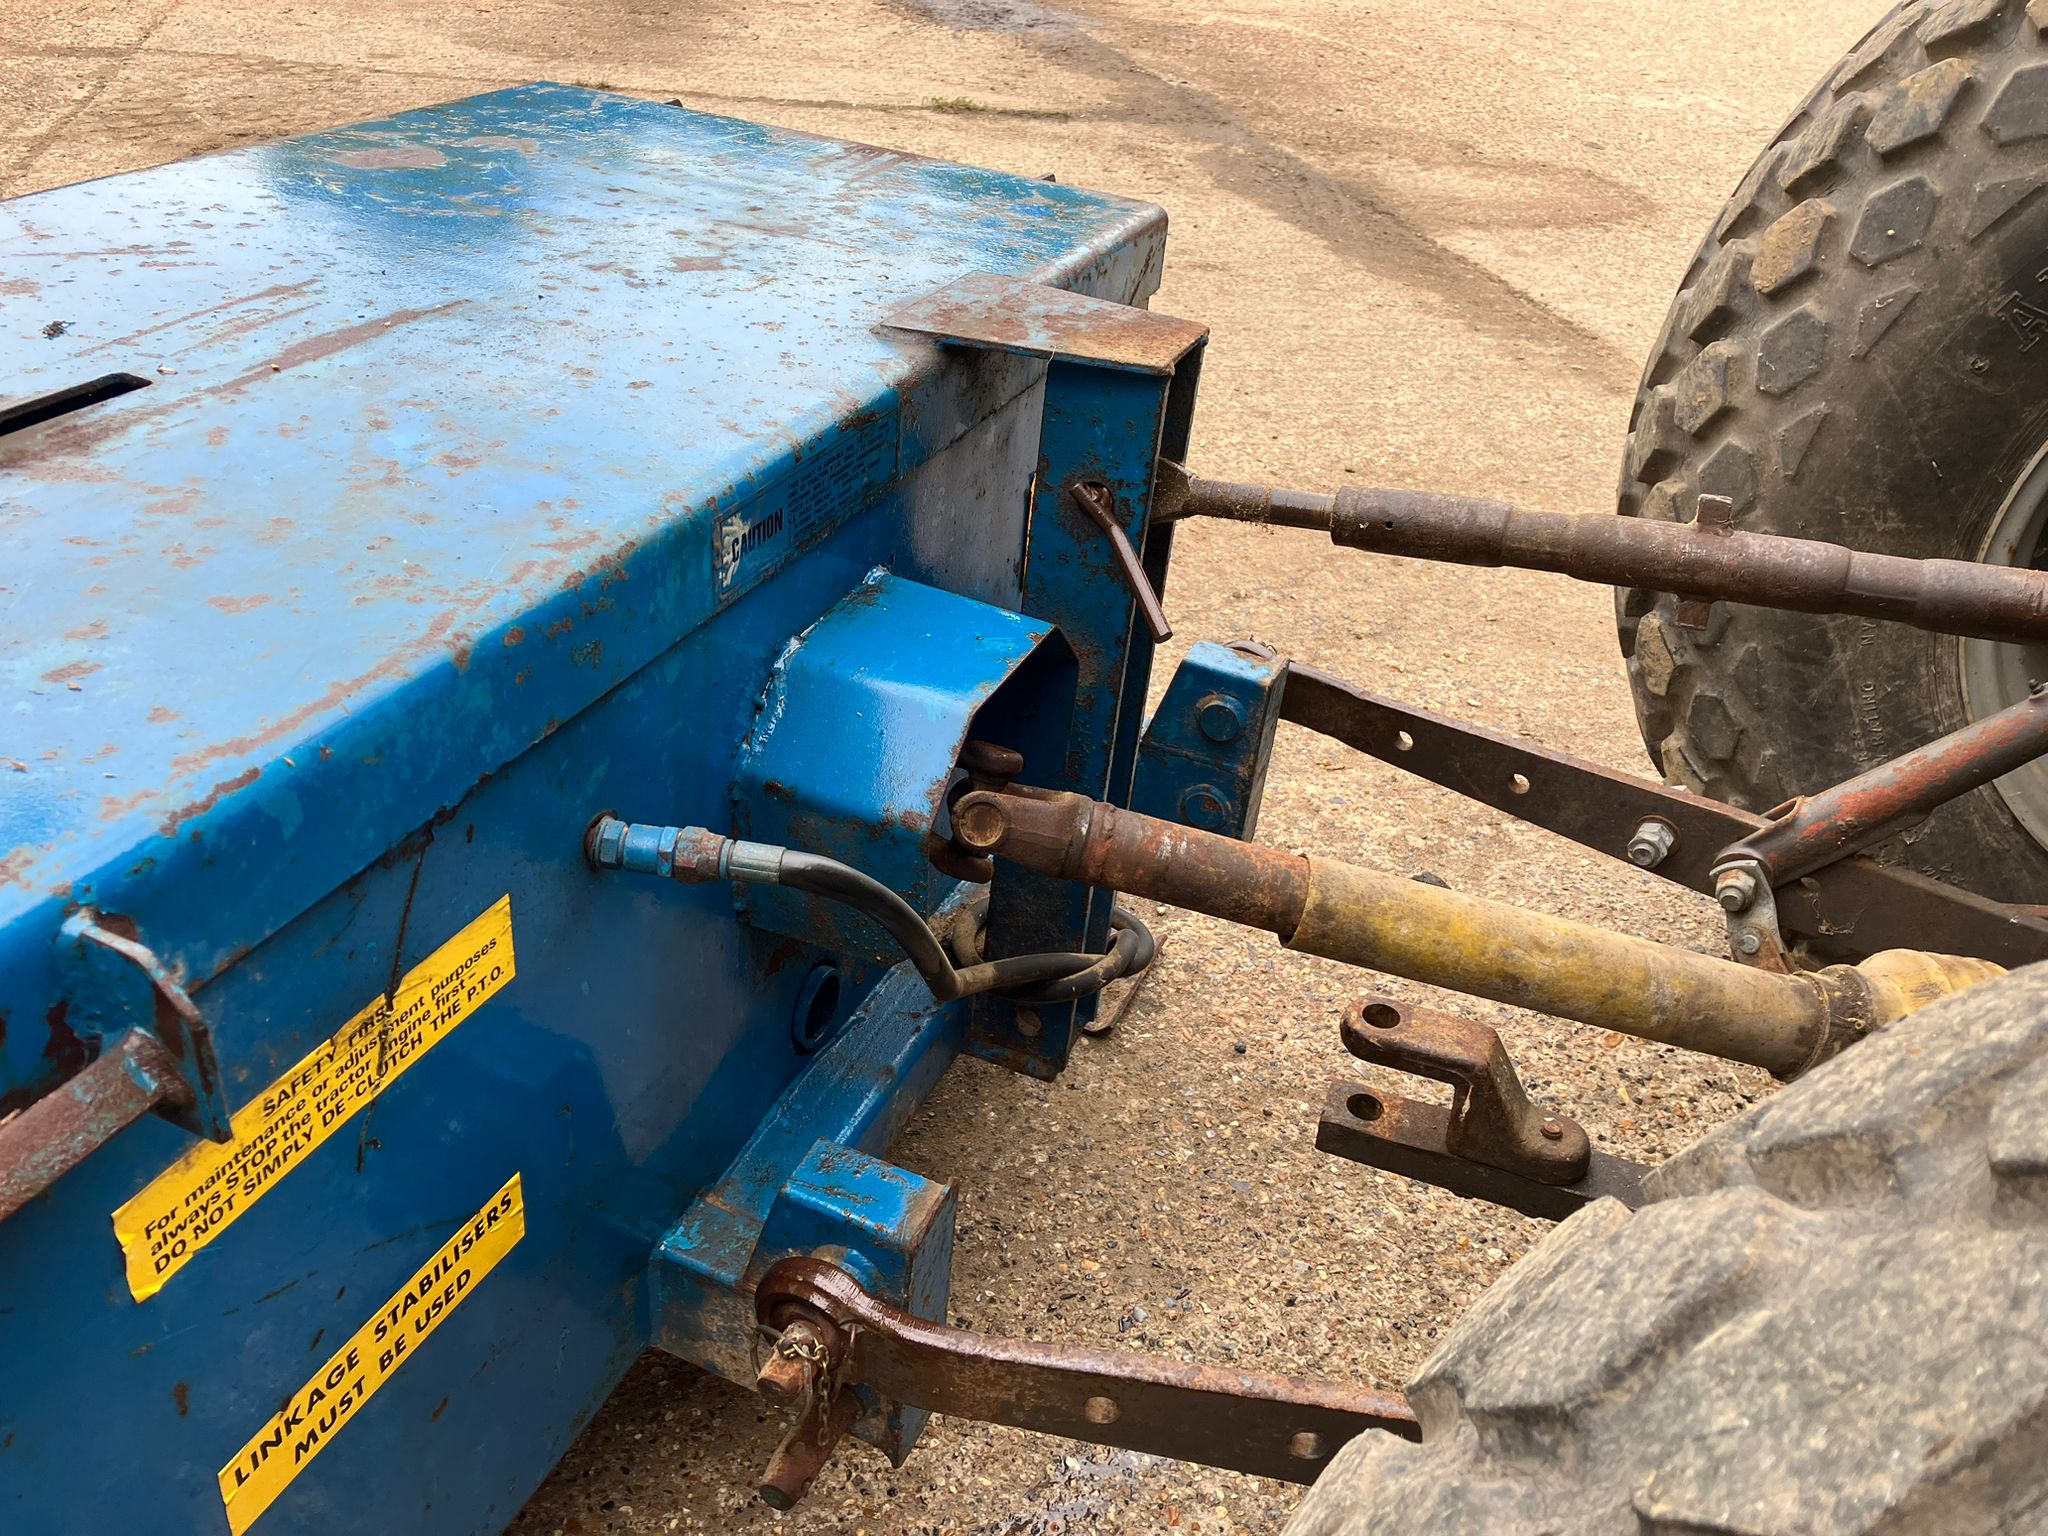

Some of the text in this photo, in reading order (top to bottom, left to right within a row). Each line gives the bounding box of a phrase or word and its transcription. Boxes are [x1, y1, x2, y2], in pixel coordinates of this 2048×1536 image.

[731, 507, 784, 563] CAUTION
[145, 1205, 178, 1240] For
[184, 1098, 306, 1208] maintenance
[312, 1079, 329, 1103] or
[431, 937, 497, 1000] purposes
[150, 1190, 221, 1257] always
[226, 1138, 277, 1192] STOP
[281, 1111, 311, 1142] the
[315, 1060, 372, 1113] tractor
[435, 979, 464, 1011] first
[155, 1244, 187, 1275] DO
[194, 1200, 235, 1242] NOT
[244, 1128, 315, 1197] SIMPLY
[430, 1000, 462, 1037] THE
[467, 965, 504, 1005] P.T.O.
[263, 1005, 392, 1117] SAFETY FIRS
[234, 1191, 511, 1487] LINKAGE STABILISERS
[294, 1268, 471, 1465] MUST BE USED
